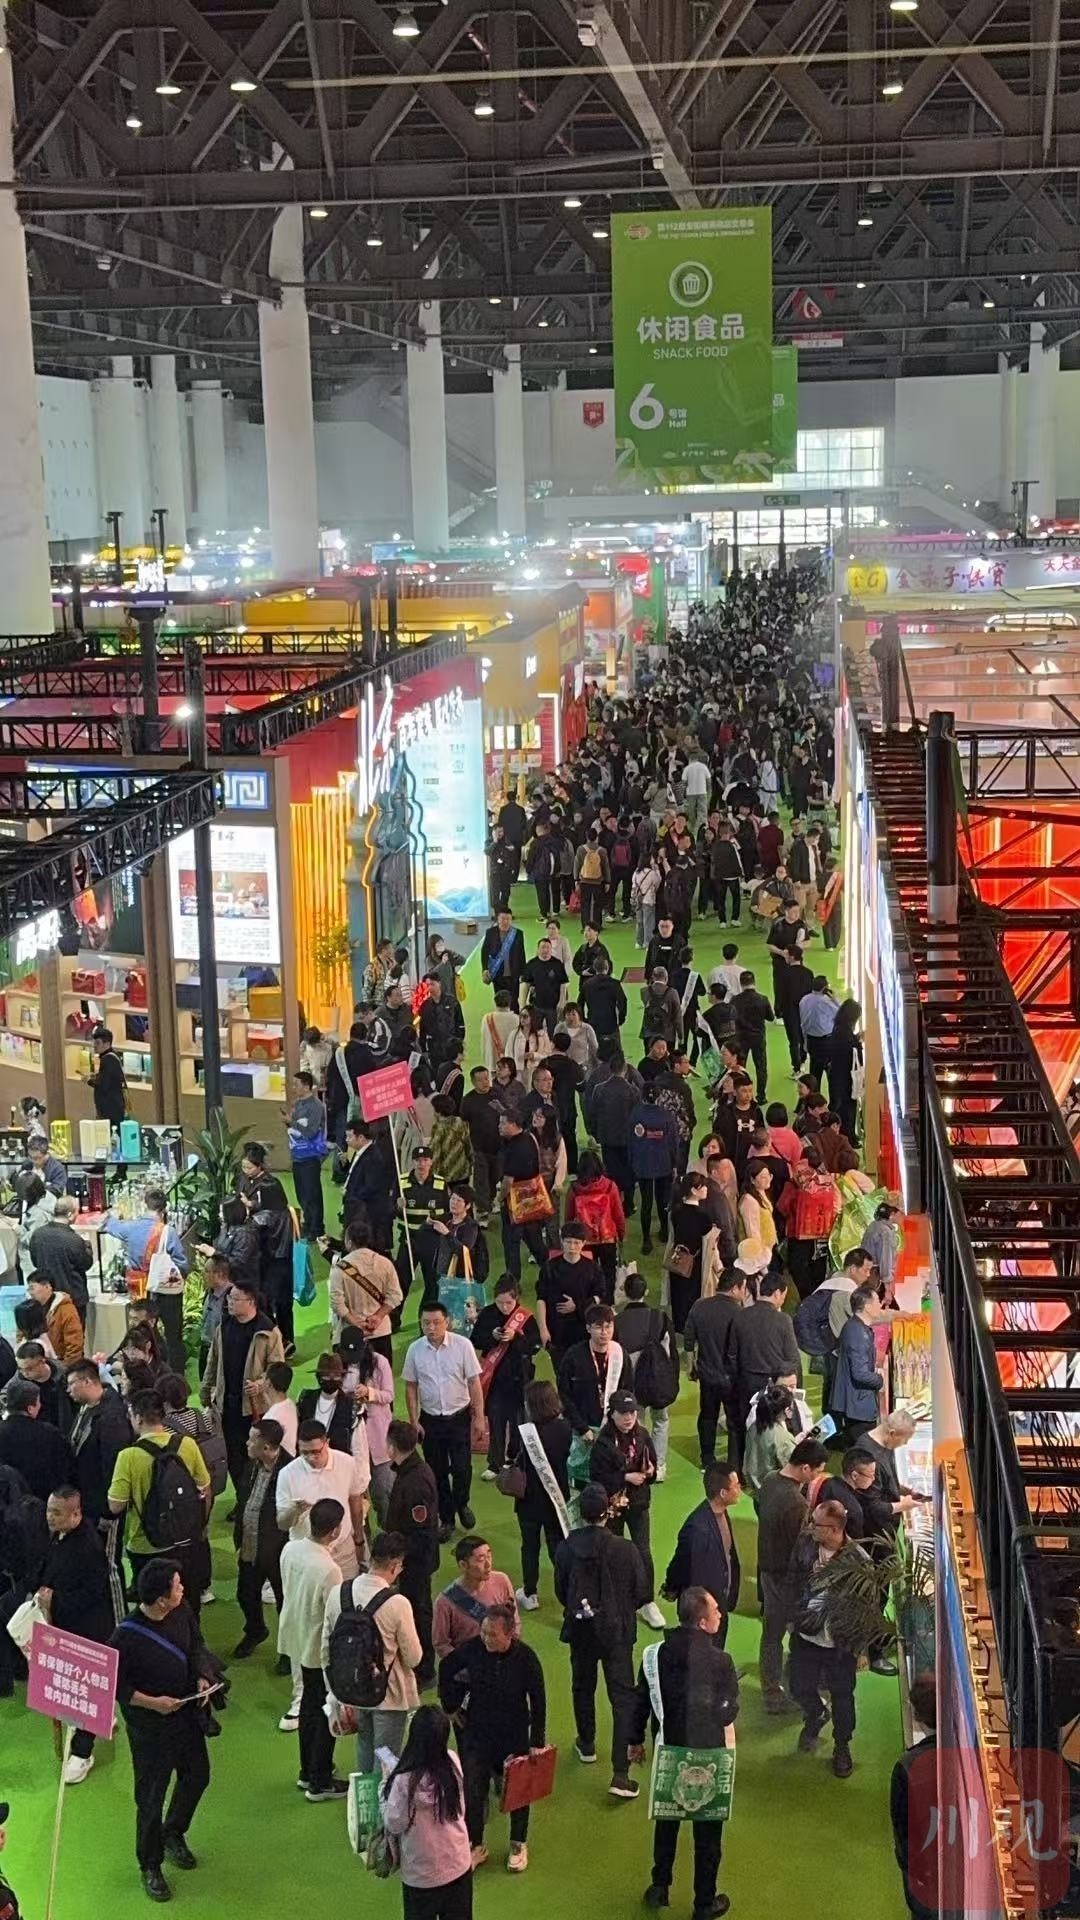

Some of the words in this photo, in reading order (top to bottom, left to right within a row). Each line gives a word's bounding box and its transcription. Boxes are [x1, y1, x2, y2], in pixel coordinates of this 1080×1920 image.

[636, 313, 745, 344] 休闲食品
[653, 347, 693, 360] SNACK
[695, 345, 729, 358] FOOD
[629, 383, 664, 430] 6
[669, 419, 687, 429] Hall
